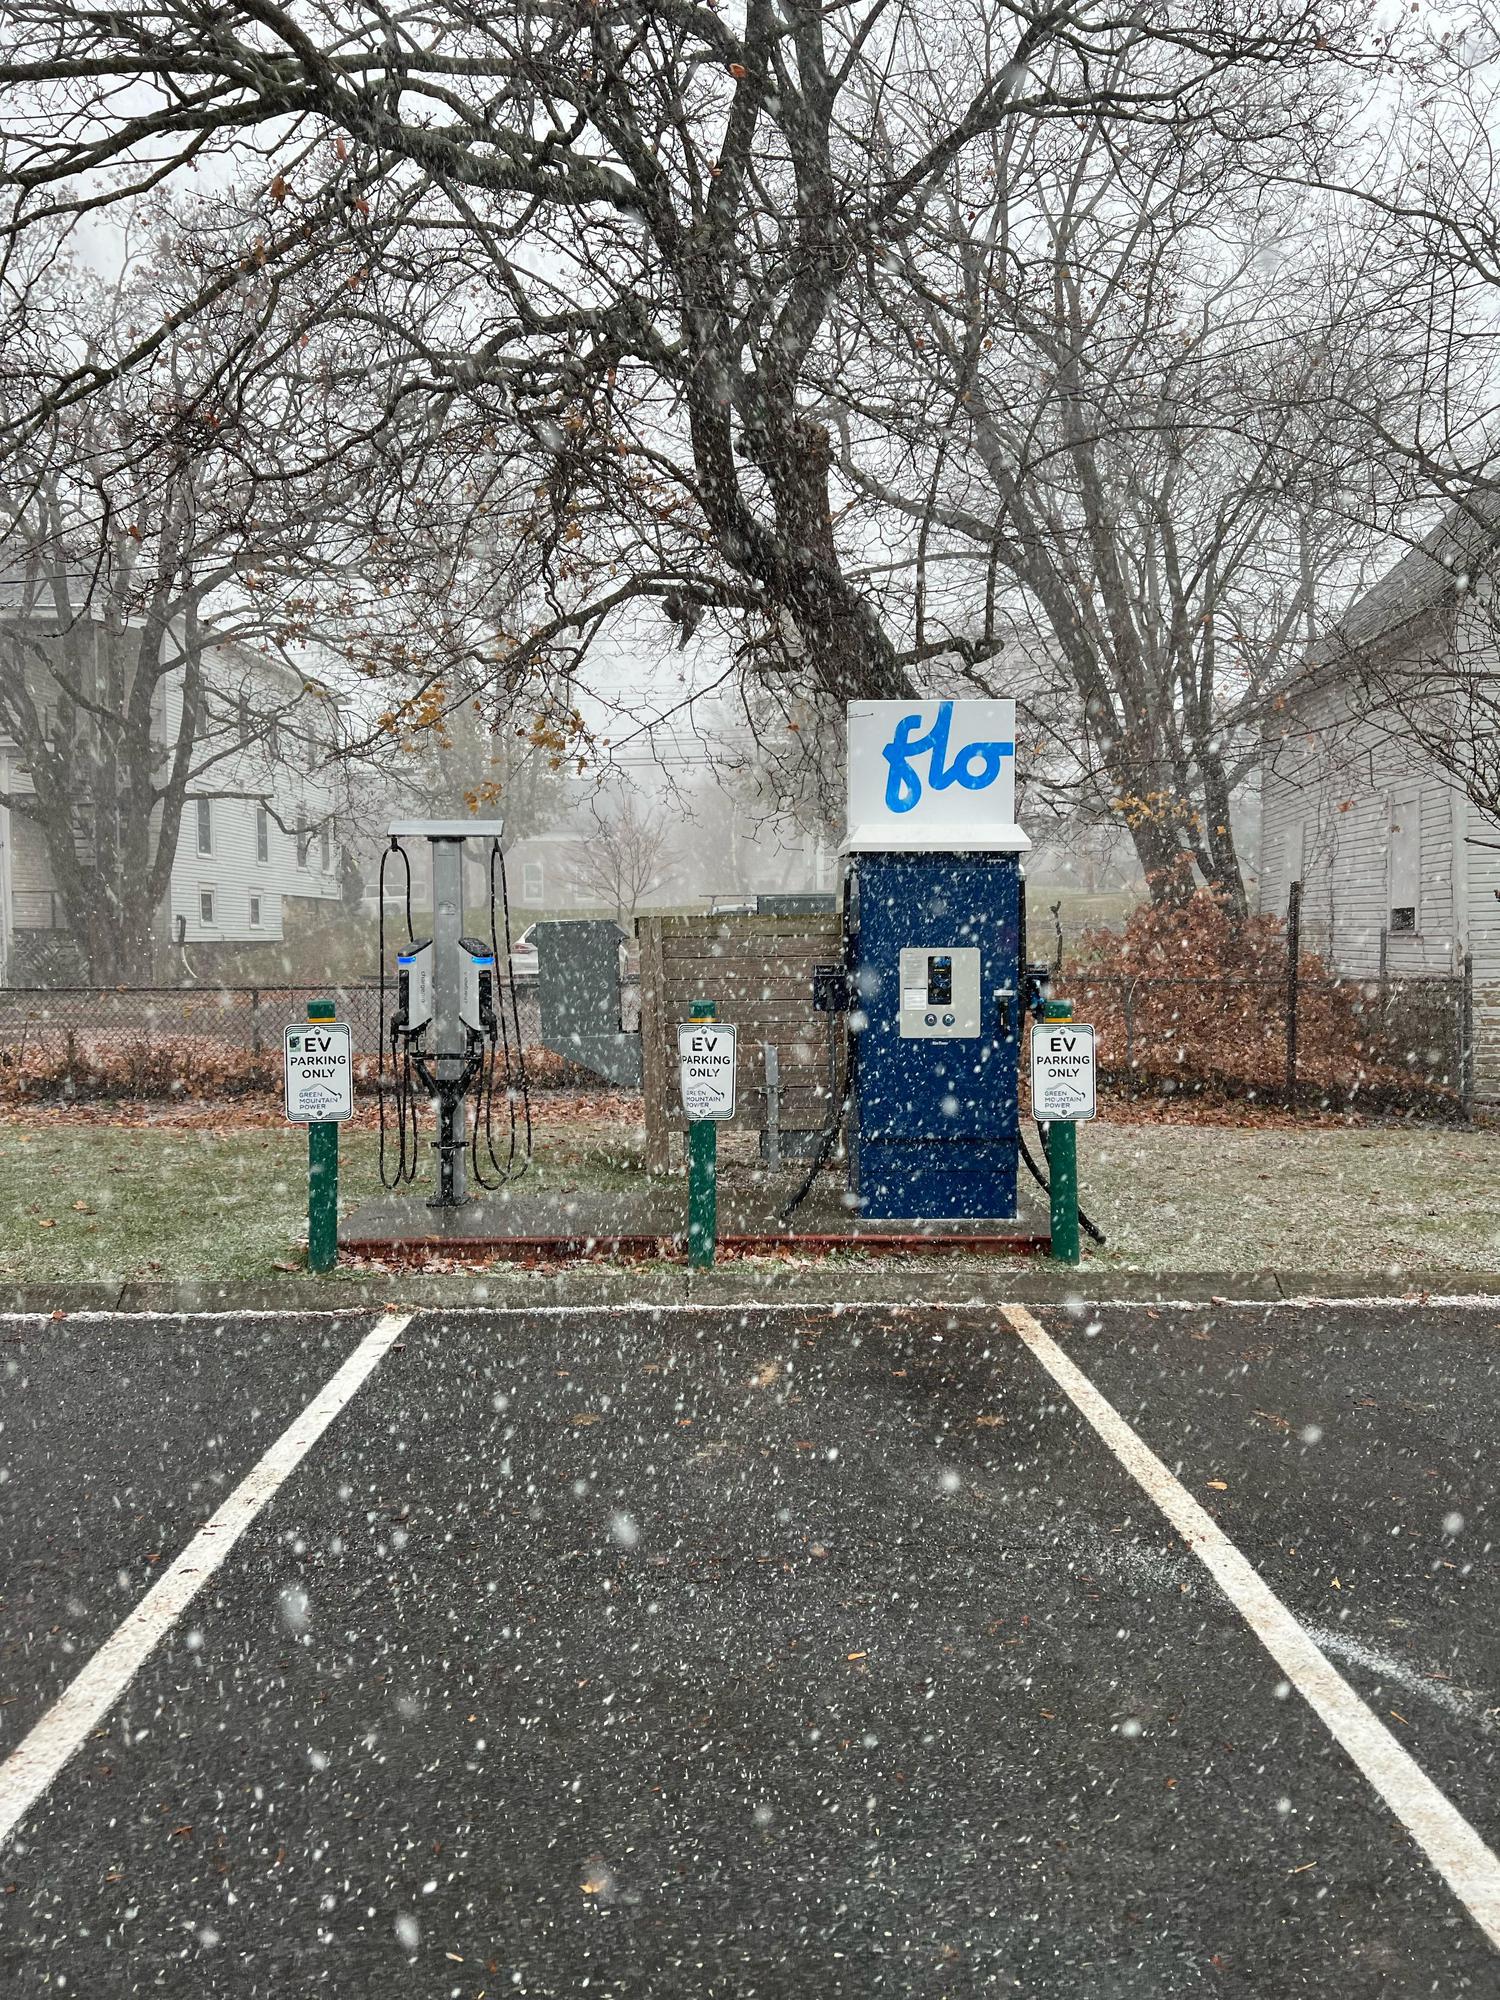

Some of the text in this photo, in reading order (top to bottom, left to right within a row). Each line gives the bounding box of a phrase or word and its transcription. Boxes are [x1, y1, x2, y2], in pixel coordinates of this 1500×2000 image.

[882, 701, 1013, 814] flo
[304, 1037, 332, 1053] EV
[692, 1037, 718, 1052] EV
[1050, 1037, 1077, 1052] EV
[290, 1055, 346, 1066] PARKING
[682, 1055, 731, 1065] PARKING
[1037, 1055, 1090, 1065] PARKING
[302, 1069, 336, 1079] ONLY
[689, 1068, 720, 1077] ONLY
[1048, 1068, 1080, 1078] ONLY
